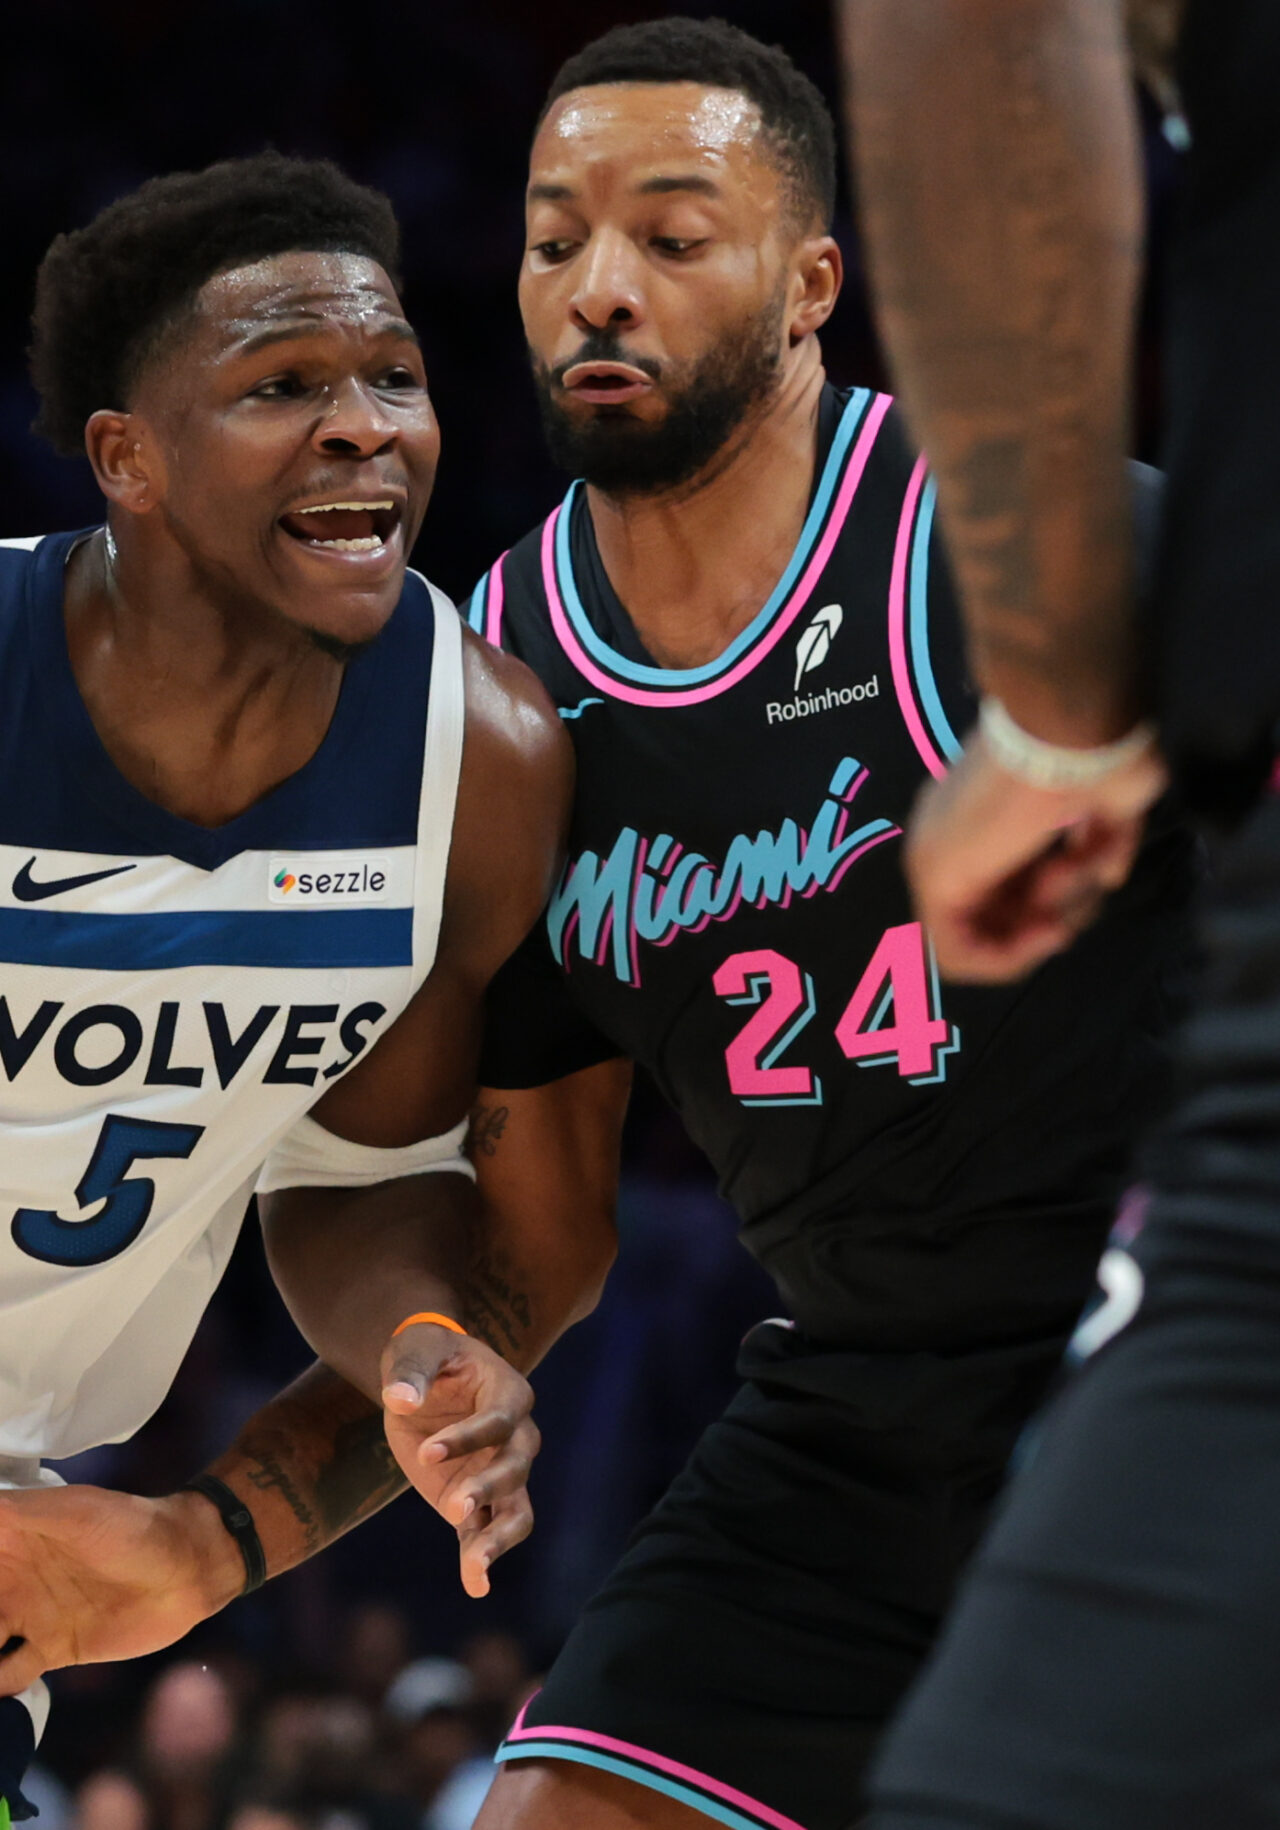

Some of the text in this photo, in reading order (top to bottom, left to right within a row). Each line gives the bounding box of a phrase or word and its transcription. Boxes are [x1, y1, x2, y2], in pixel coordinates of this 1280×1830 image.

[766, 674, 879, 725] Robinhood
[298, 863, 386, 894] sezzle
[547, 757, 903, 988] Miami
[712, 921, 960, 1106] 24
[10, 1113, 206, 1267] 5
